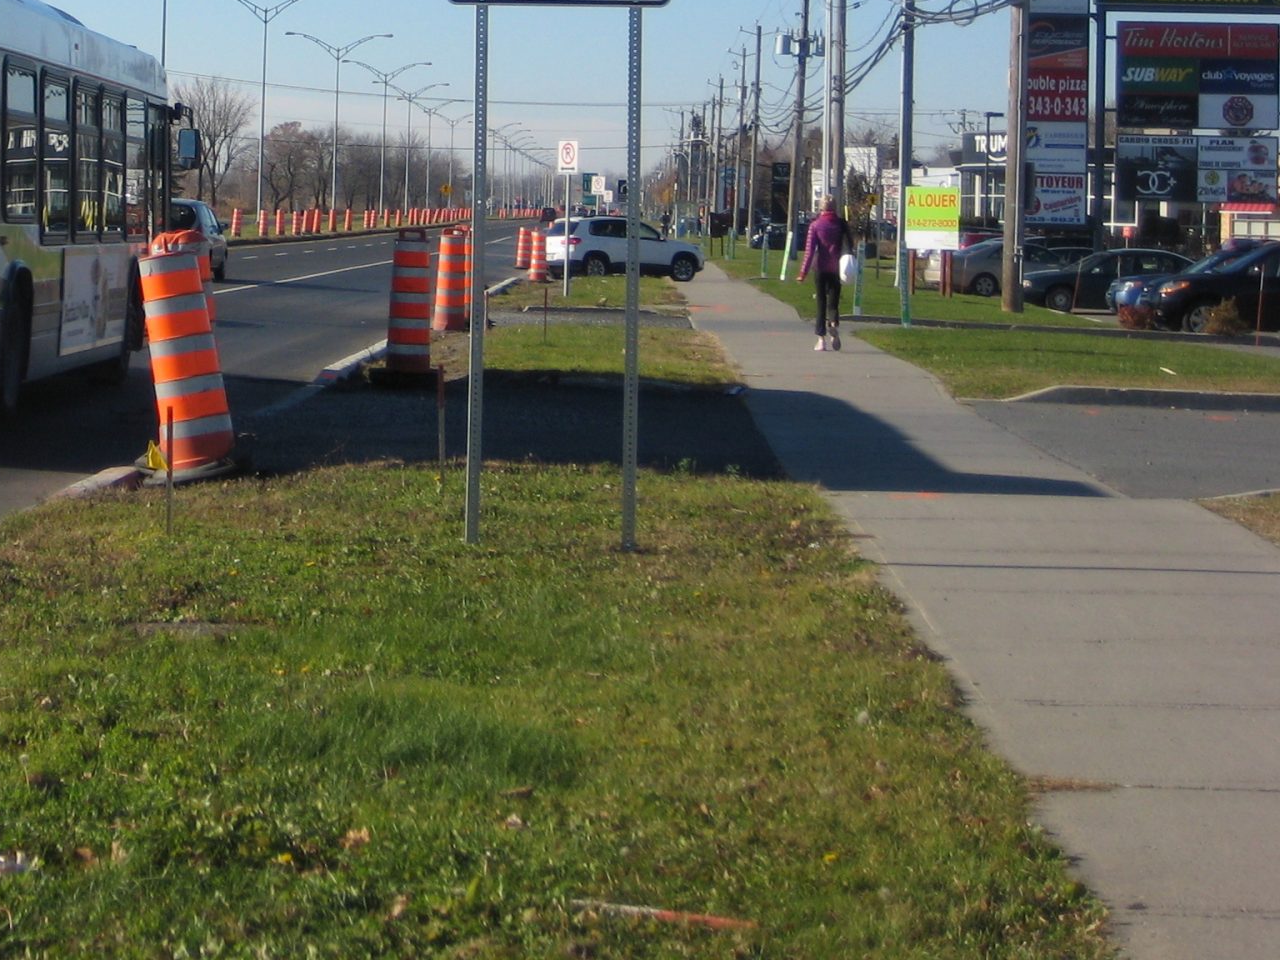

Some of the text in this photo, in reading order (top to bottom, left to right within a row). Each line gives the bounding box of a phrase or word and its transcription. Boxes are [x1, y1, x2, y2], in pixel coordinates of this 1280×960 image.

[1123, 27, 1224, 49] Tim Hortons
[1122, 66, 1193, 82] SUBWAY
[1202, 70, 1275, 84] club voyages
[1028, 74, 1087, 93] ouble pizza
[974, 134, 1008, 153] TRUM
[1036, 175, 1083, 189] TTOYEUR
[919, 194, 956, 208] LOUER
